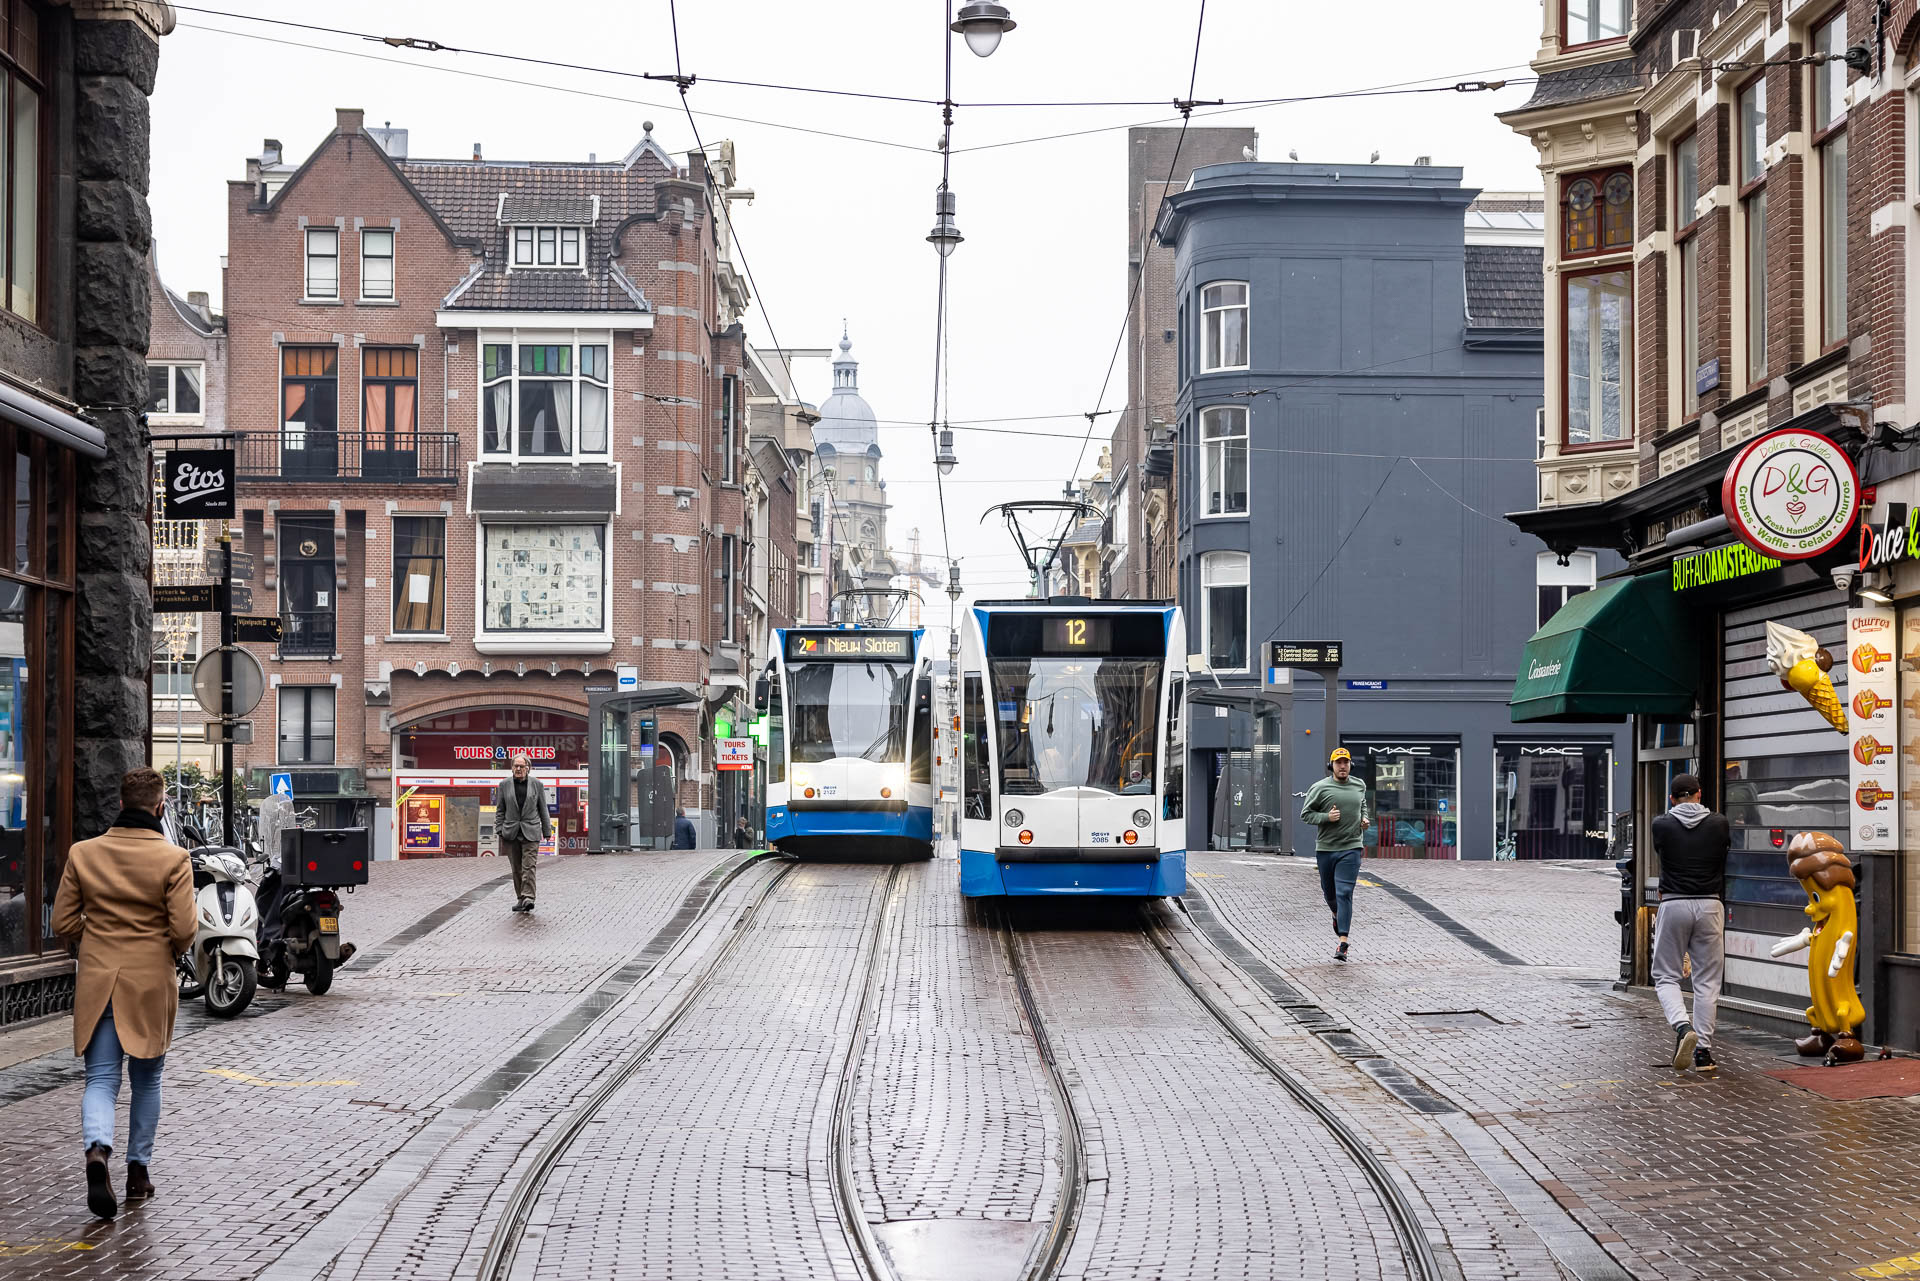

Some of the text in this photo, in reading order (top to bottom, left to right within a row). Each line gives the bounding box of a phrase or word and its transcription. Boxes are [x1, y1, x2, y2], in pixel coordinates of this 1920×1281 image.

[1760, 438, 1832, 459] Dolce & Gelato
[174, 463, 224, 492] Etos
[1763, 462, 1828, 498] D&G
[1740, 480, 1850, 548] Crepes Waffle Gelato Churros
[1764, 514, 1827, 534] Fresh Handmade
[1860, 503, 1920, 573] Dolce &
[1673, 543, 1782, 592] BUFFALOAMSTERD
[1066, 620, 1086, 644] 12
[1852, 617, 1890, 630] Churros
[799, 638, 900, 654] 2 Nieuw Sloten
[454, 746, 555, 759] TOURS & TICKETS
